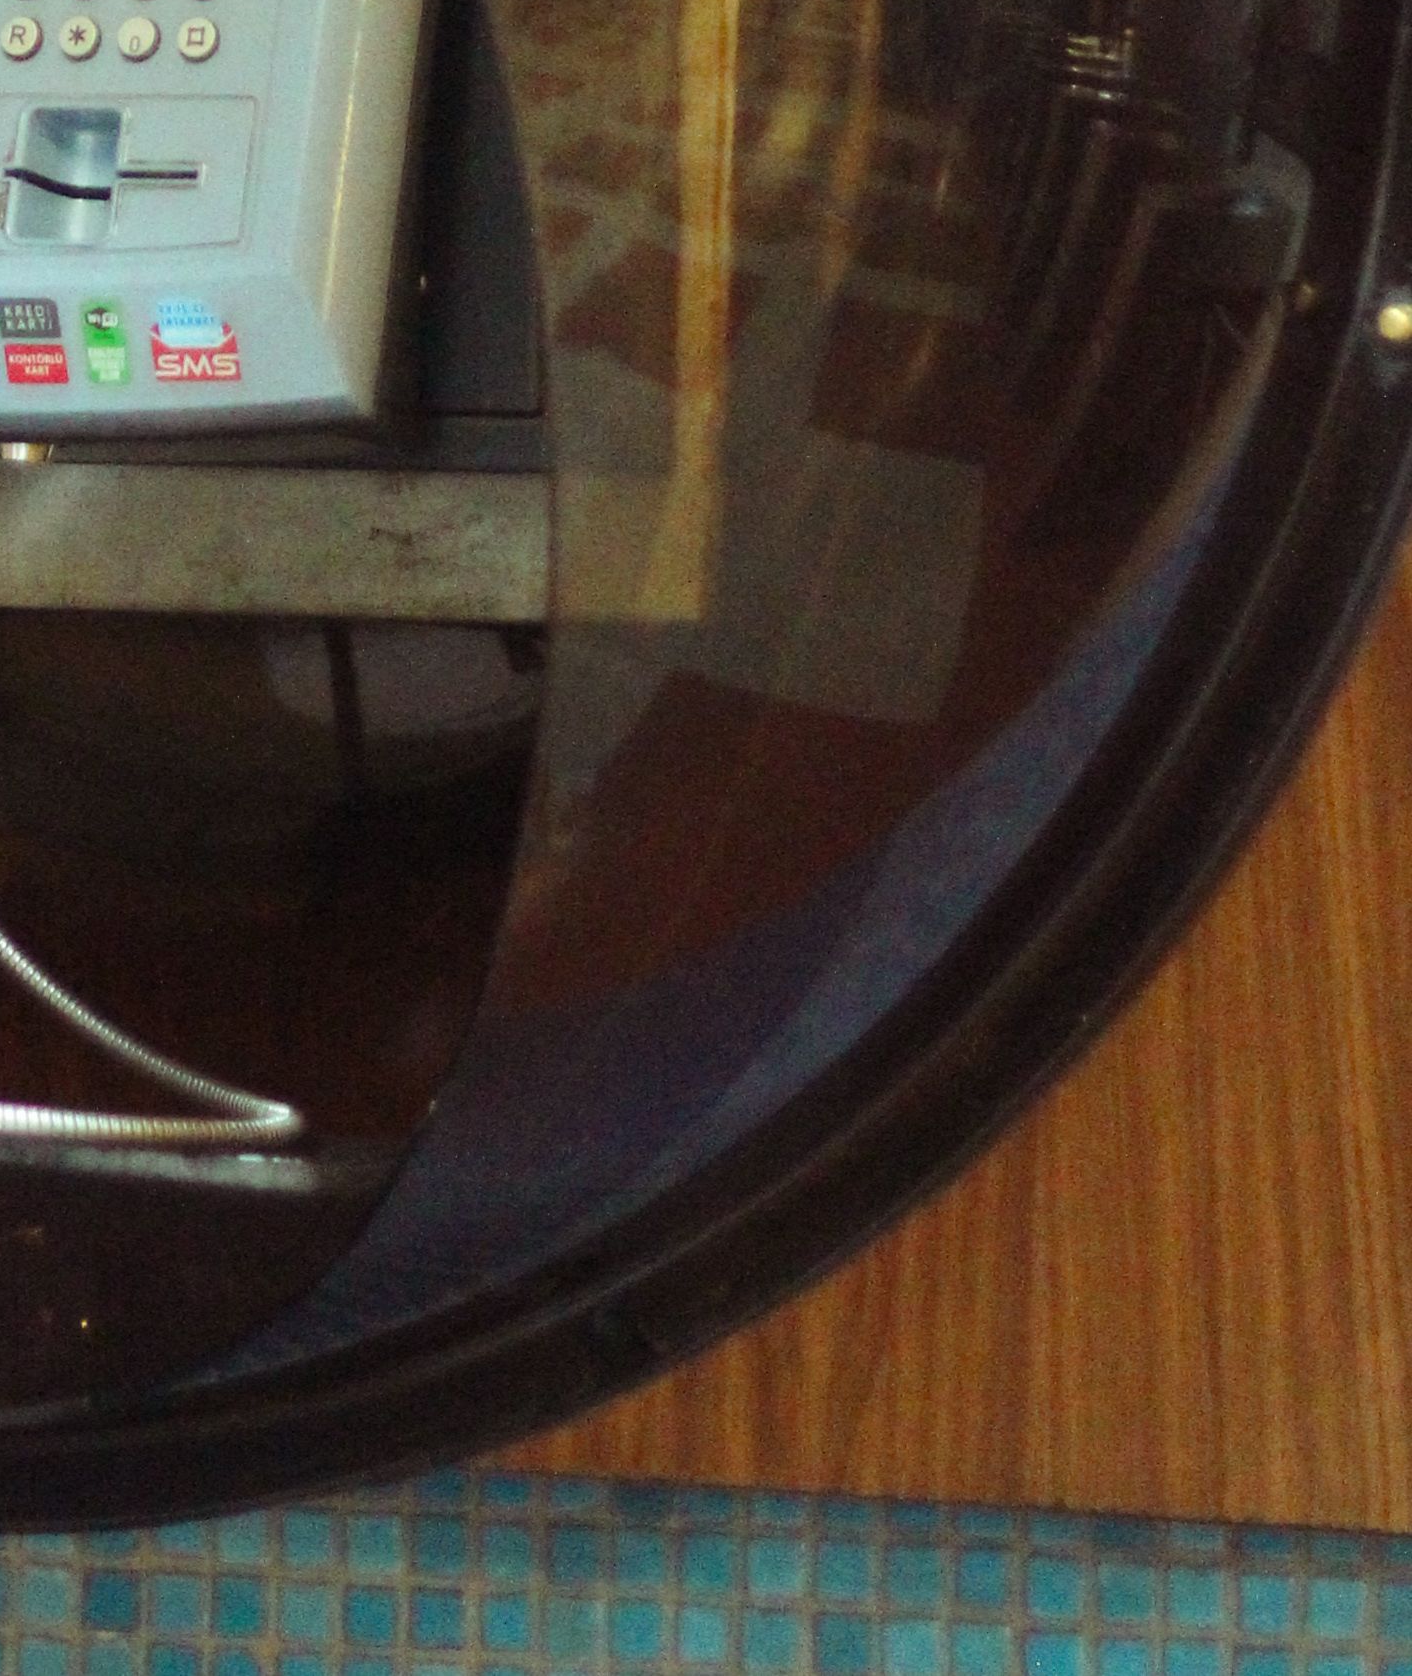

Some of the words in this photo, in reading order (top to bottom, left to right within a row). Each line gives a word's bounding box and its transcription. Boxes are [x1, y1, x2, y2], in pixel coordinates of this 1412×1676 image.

[9, 24, 26, 46] R
[130, 36, 140, 53] 0
[6, 317, 53, 330] KARTI
[24, 365, 50, 376] KART
[155, 352, 240, 377] SMS
